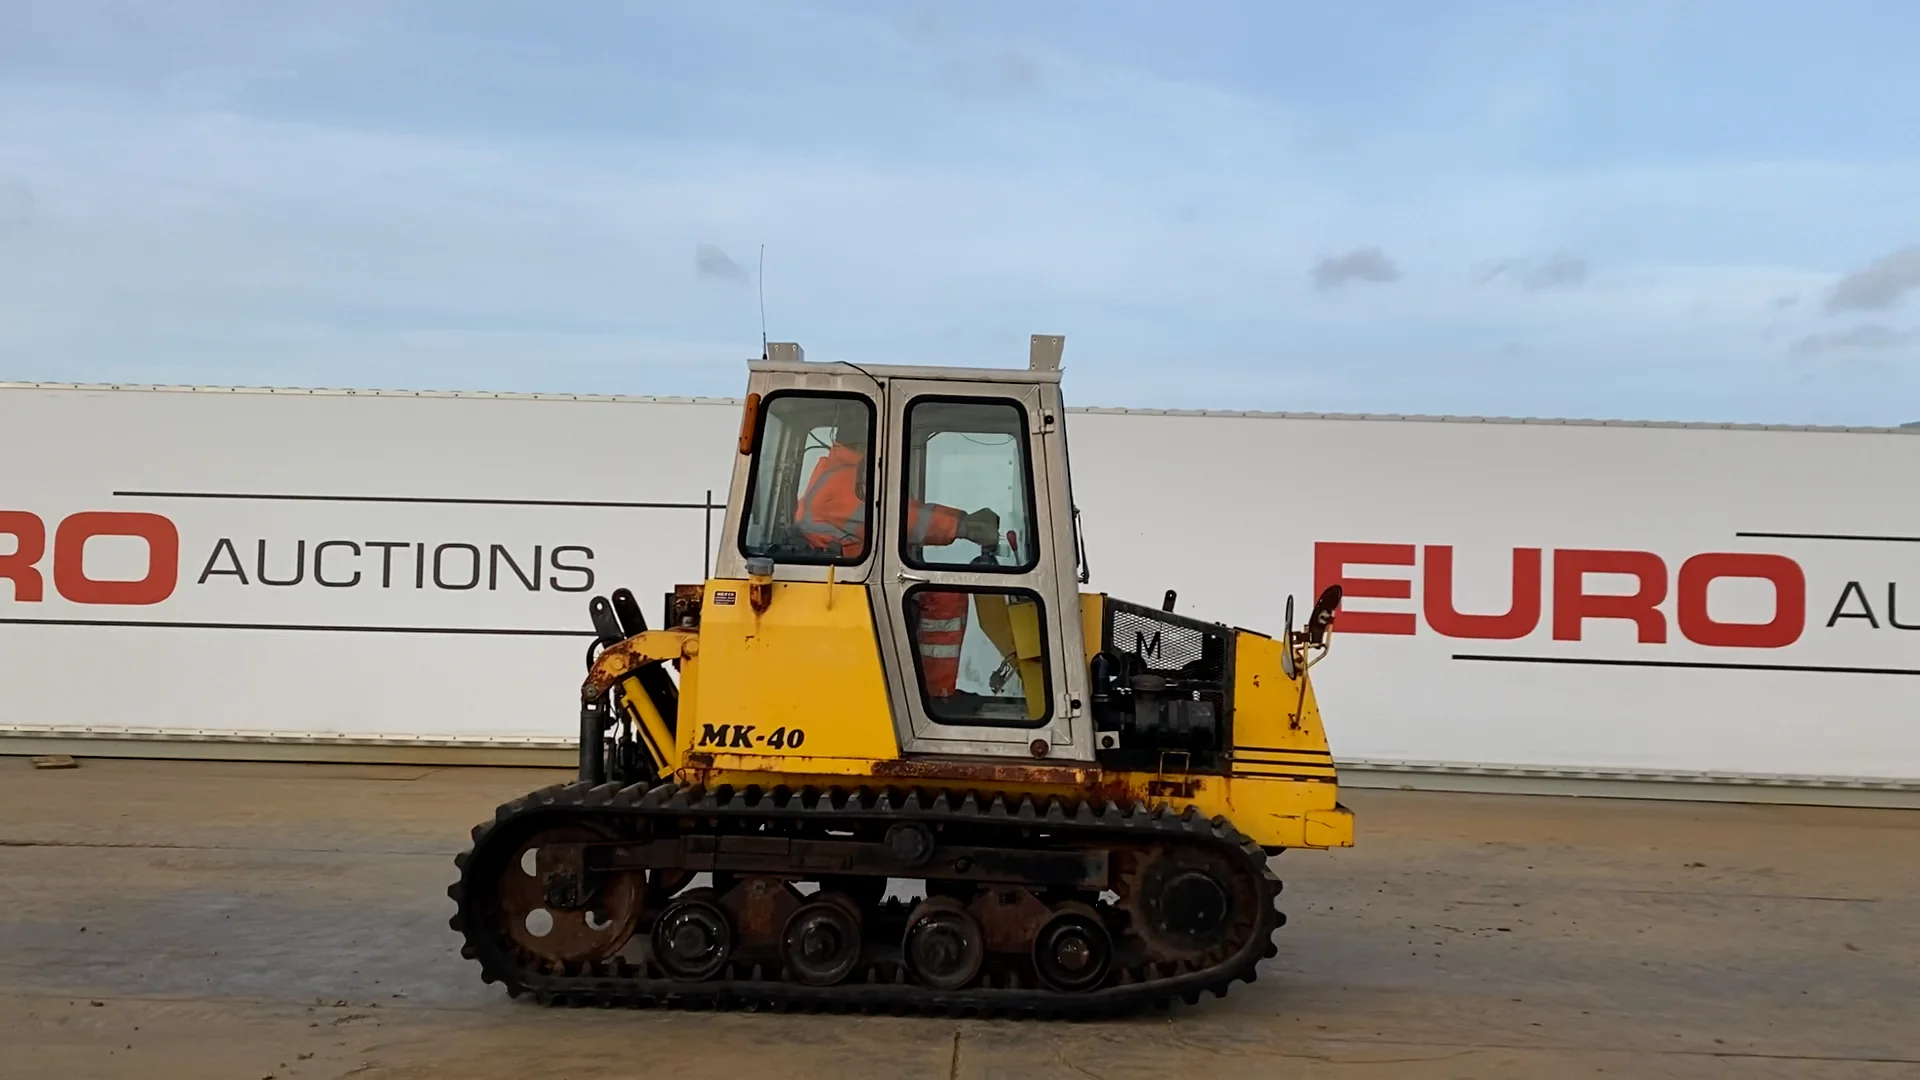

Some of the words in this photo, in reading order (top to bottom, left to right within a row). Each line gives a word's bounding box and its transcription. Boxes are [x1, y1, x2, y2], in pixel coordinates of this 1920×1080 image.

[198, 538, 595, 592] AUCTIONS
[1314, 542, 1806, 648] EURO
[698, 723, 805, 749] MK-40
